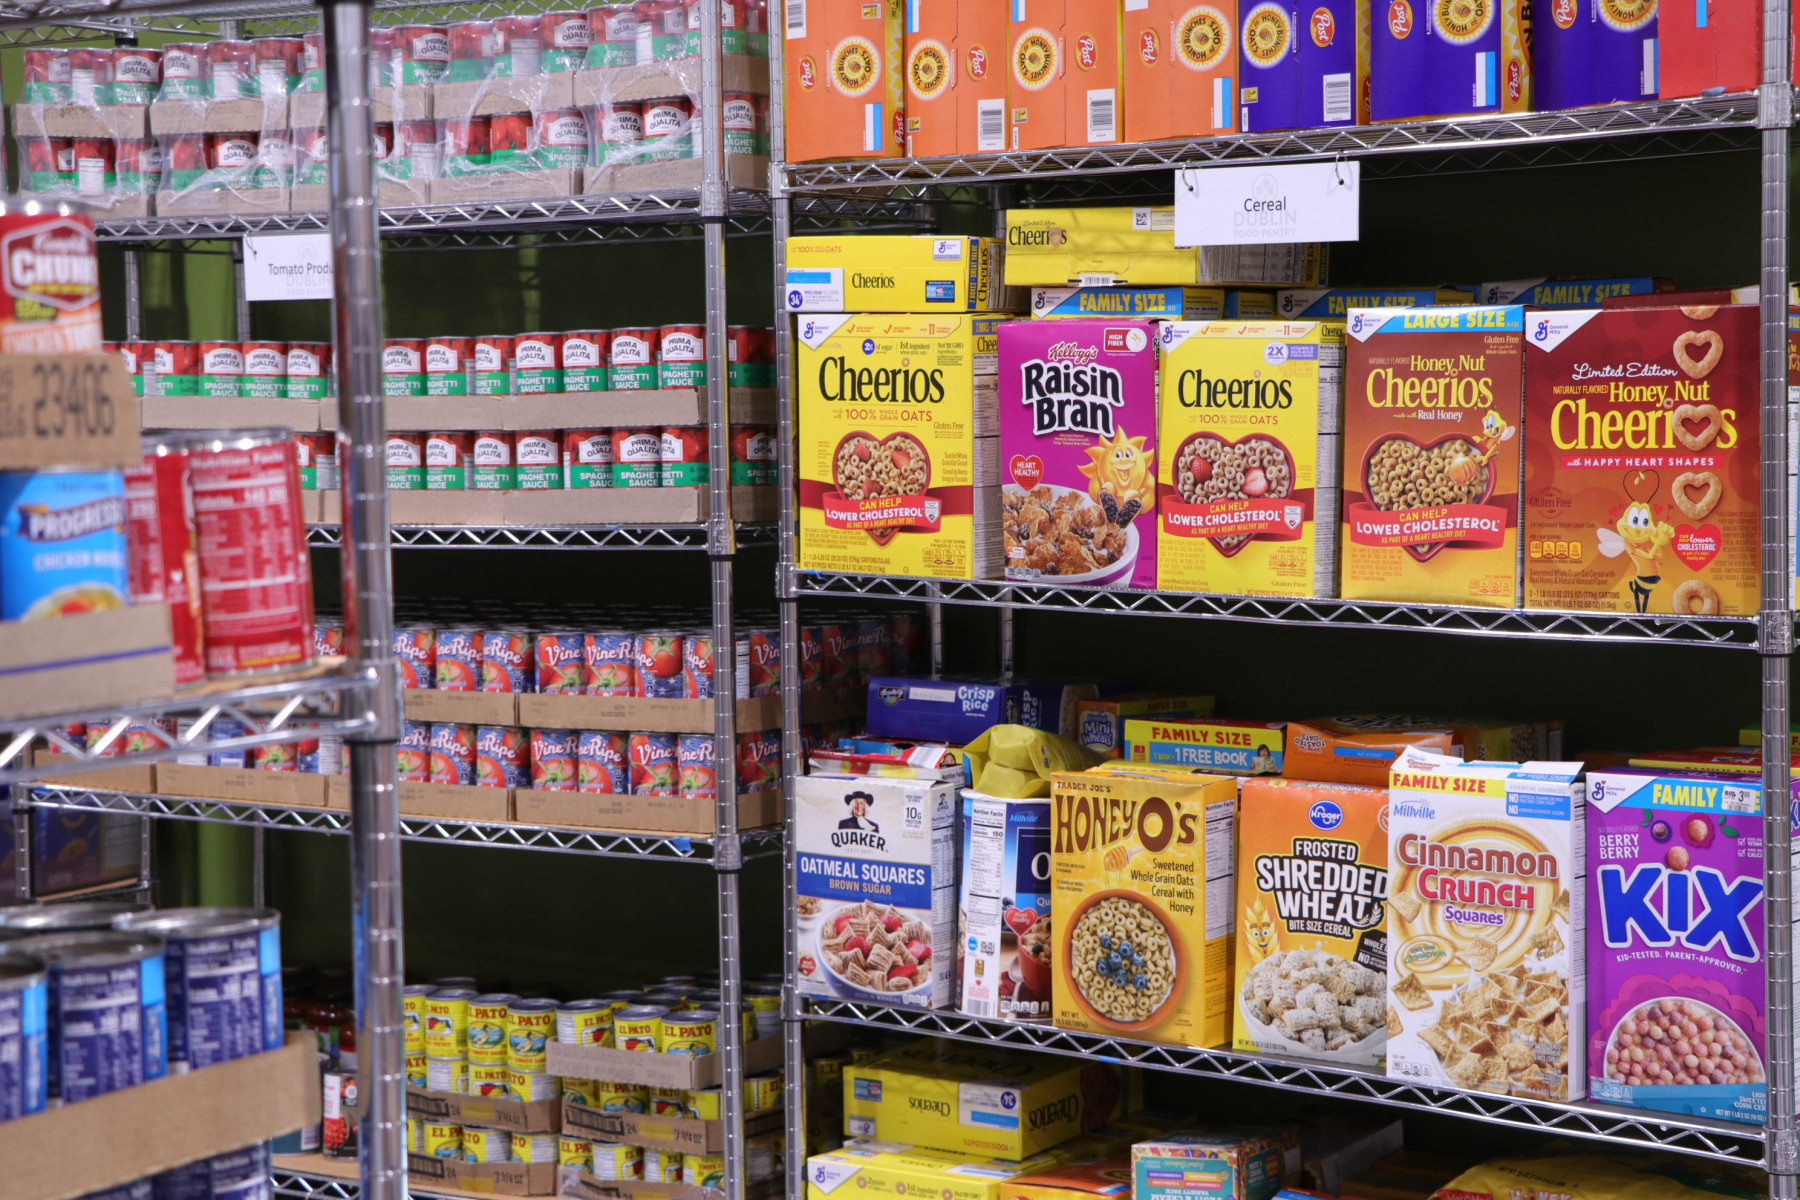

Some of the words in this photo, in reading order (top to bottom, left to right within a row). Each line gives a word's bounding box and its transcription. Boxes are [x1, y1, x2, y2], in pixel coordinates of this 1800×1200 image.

[1262, 14, 1282, 29] HONEY
[1393, 4, 1409, 32] Post
[1315, 14, 1331, 41] Post
[1250, 30, 1259, 53] OATS
[1262, 30, 1283, 56] BUNCHES
[1079, 39, 1094, 65] Post
[801, 62, 814, 88] Post
[653, 111, 677, 119] PRIMA
[650, 119, 680, 129] QUALITA
[226, 143, 250, 151] PRIMA
[1244, 197, 1286, 211] Cereal
[1234, 211, 1296, 227] DUBLIN
[1234, 230, 1258, 238] FOOD
[1262, 229, 1295, 237] PANTRY
[268, 264, 304, 275] Tomato
[979, 248, 988, 302] Cheerios
[852, 273, 895, 288] Cheerios
[1079, 294, 1130, 311] FAMILY
[1135, 294, 1165, 310] SIZE
[1404, 314, 1459, 328] LARGE
[1466, 312, 1505, 327] SIZE
[1322, 325, 1343, 337] Cheerios
[1484, 336, 1503, 344] Gluten
[1504, 336, 1519, 344] Free
[666, 346, 694, 355] QUALITA
[1049, 343, 1098, 363] Kellogg's
[1268, 346, 1283, 356] 2X
[1411, 356, 1453, 375] Honey
[1459, 356, 1485, 371] Nut
[1572, 363, 1624, 380] Limited
[1626, 362, 1678, 377] Edition
[668, 378, 693, 386] SAUCE
[819, 356, 944, 403] Cheerios
[1024, 363, 1121, 404] Raisin
[1178, 369, 1293, 409] Cheerios
[1367, 368, 1493, 408] Cheerios
[1553, 386, 1582, 394] NATURALLY
[1583, 386, 1608, 394] FLAVORED
[1610, 382, 1668, 407] Honey
[1674, 381, 1710, 400] Nut
[845, 409, 876, 420] 100%
[901, 411, 932, 421] OATS
[1037, 399, 1112, 434] Bran
[1199, 414, 1227, 424] 100%
[1250, 416, 1278, 425] OATS
[1418, 410, 1435, 420] Real
[1437, 410, 1463, 420] Honey
[934, 422, 951, 430] Gluten
[627, 447, 660, 456] QUALITA
[1626, 458, 1663, 466] HEART
[1668, 458, 1714, 466] SHAPES
[1014, 469, 1039, 477] HEALTHY
[860, 501, 877, 510] CAN
[879, 498, 901, 507] HELP
[1210, 504, 1226, 512] CAN
[1228, 502, 1249, 511] HELP
[826, 510, 858, 521] LOWER
[859, 507, 923, 520] CHOLESTEROL
[1168, 514, 1203, 526] LOWER
[1206, 510, 1281, 525] CHOLESTEROL
[1400, 513, 1418, 521] CAN
[1421, 509, 1448, 519] HELP
[1357, 522, 1400, 535] LOWER
[1403, 518, 1499, 534] CHOLESTEROL
[1432, 532, 1453, 540] HEALTHY
[1690, 534, 1714, 543] lower
[492, 639, 522, 663] Ripe
[546, 647, 582, 665] Vine
[587, 646, 616, 666] Vine
[958, 687, 995, 701] Crisp
[962, 700, 988, 712] Rice
[1084, 722, 1112, 735] Mini
[1152, 727, 1208, 743] FAMILY
[1219, 731, 1252, 746] SIZE
[485, 734, 516, 758] Ripe
[1295, 738, 1326, 747] TOASTED
[637, 745, 672, 764] Vine
[1183, 748, 1210, 763] FREE
[1214, 751, 1247, 766] BOOK
[1057, 782, 1087, 791] TRADER
[1090, 784, 1111, 792] JOE'S
[1393, 774, 1448, 790] FAMILY
[1453, 778, 1486, 793] SIZE
[1509, 793, 1519, 803] NO
[1653, 784, 1718, 807] FAMILY
[1311, 806, 1341, 825] Kroger
[1394, 803, 1435, 819] Millville
[1509, 805, 1518, 814] NO
[1010, 815, 1038, 823] Millville
[1055, 795, 1136, 853] HONEY
[831, 832, 886, 851] QUAKER
[1600, 834, 1639, 847] BERRY
[1295, 840, 1356, 861] FROSTED
[1400, 834, 1557, 877] Cinnamon
[1600, 847, 1639, 858] BERRY
[801, 857, 858, 878] OATMEAL
[862, 864, 925, 885] SQUARES
[1153, 858, 1194, 872] Sweetened
[1131, 870, 1153, 882] Whole
[1155, 873, 1174, 883] Grain
[1176, 875, 1194, 886] Oats
[1257, 858, 1388, 898] SHREDDED
[830, 879, 860, 891] BROWN
[862, 882, 891, 895] SUGAR
[1152, 885, 1174, 897] Cereal
[1176, 889, 1194, 899] with
[1170, 903, 1194, 916] Honey
[1276, 891, 1372, 923] WHEAT
[1600, 865, 1764, 960] KIX
[1289, 920, 1304, 931] BITE
[1306, 921, 1322, 933] SIZE
[1324, 923, 1351, 937] CEREAL
[1617, 951, 1662, 962] KID-TESTED.
[1665, 952, 1743, 974] PARENT-APPROVED.
[518, 1016, 550, 1025] PATO
[664, 1026, 676, 1036] EL
[679, 1026, 711, 1038] PATO
[909, 1096, 950, 1117] Cheerios
[1029, 1094, 1078, 1132] Cheerios
